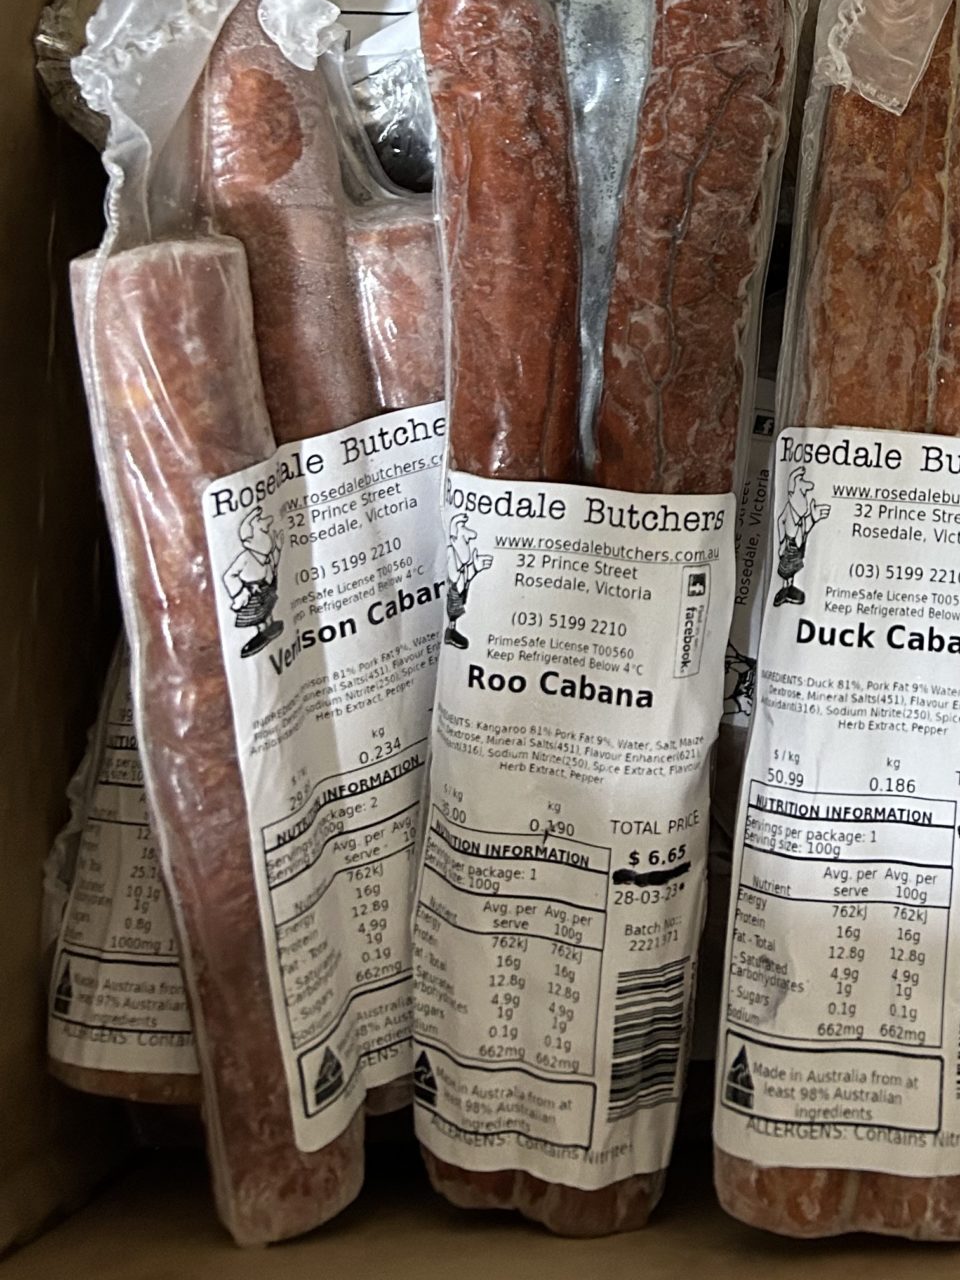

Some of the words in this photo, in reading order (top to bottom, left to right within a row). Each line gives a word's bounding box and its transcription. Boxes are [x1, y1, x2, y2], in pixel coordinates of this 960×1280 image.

[340, 417, 446, 465] Butche
[780, 436, 902, 470] Rosedale
[312, 498, 357, 522] Prince
[361, 482, 401, 505] Street
[367, 496, 418, 522] Victoria
[854, 504, 872, 518] 32
[878, 504, 925, 521] Prince
[584, 497, 724, 532] Butchers
[852, 524, 926, 543] Rosedale,
[495, 535, 719, 562] www.rosedalebutchers.com.au
[295, 566, 326, 584] (03)
[331, 551, 367, 573] 5199
[371, 538, 401, 560] 2210
[517, 555, 535, 567] 32
[542, 555, 589, 573] Prince
[595, 561, 638, 579] Street
[849, 564, 880, 580] (03)
[886, 567, 923, 581] 5199
[515, 573, 589, 593] Rosedale,
[596, 581, 651, 601] Victoria
[826, 586, 882, 601] PrimeSafe
[886, 590, 927, 603] License
[512, 612, 543, 628] (03)
[549, 614, 586, 631] 5199
[591, 619, 627, 636] 2210
[928, 607, 960, 620] Below
[797, 619, 875, 648] Duck
[468, 664, 527, 693] Roo
[540, 671, 654, 708] Cabana
[359, 738, 401, 764] 0.234
[767, 768, 804, 787] 50.99
[869, 777, 916, 794] 0.186
[611, 820, 661, 835] TOTAL
[668, 810, 699, 833] PRICE
[826, 806, 932, 824] INFORMATION
[807, 828, 866, 845] package:
[486, 844, 589, 868] INFORMATION
[629, 851, 639, 866] $
[648, 844, 686, 866] 6.65
[808, 842, 840, 858] 100g
[896, 886, 927, 904] 100g
